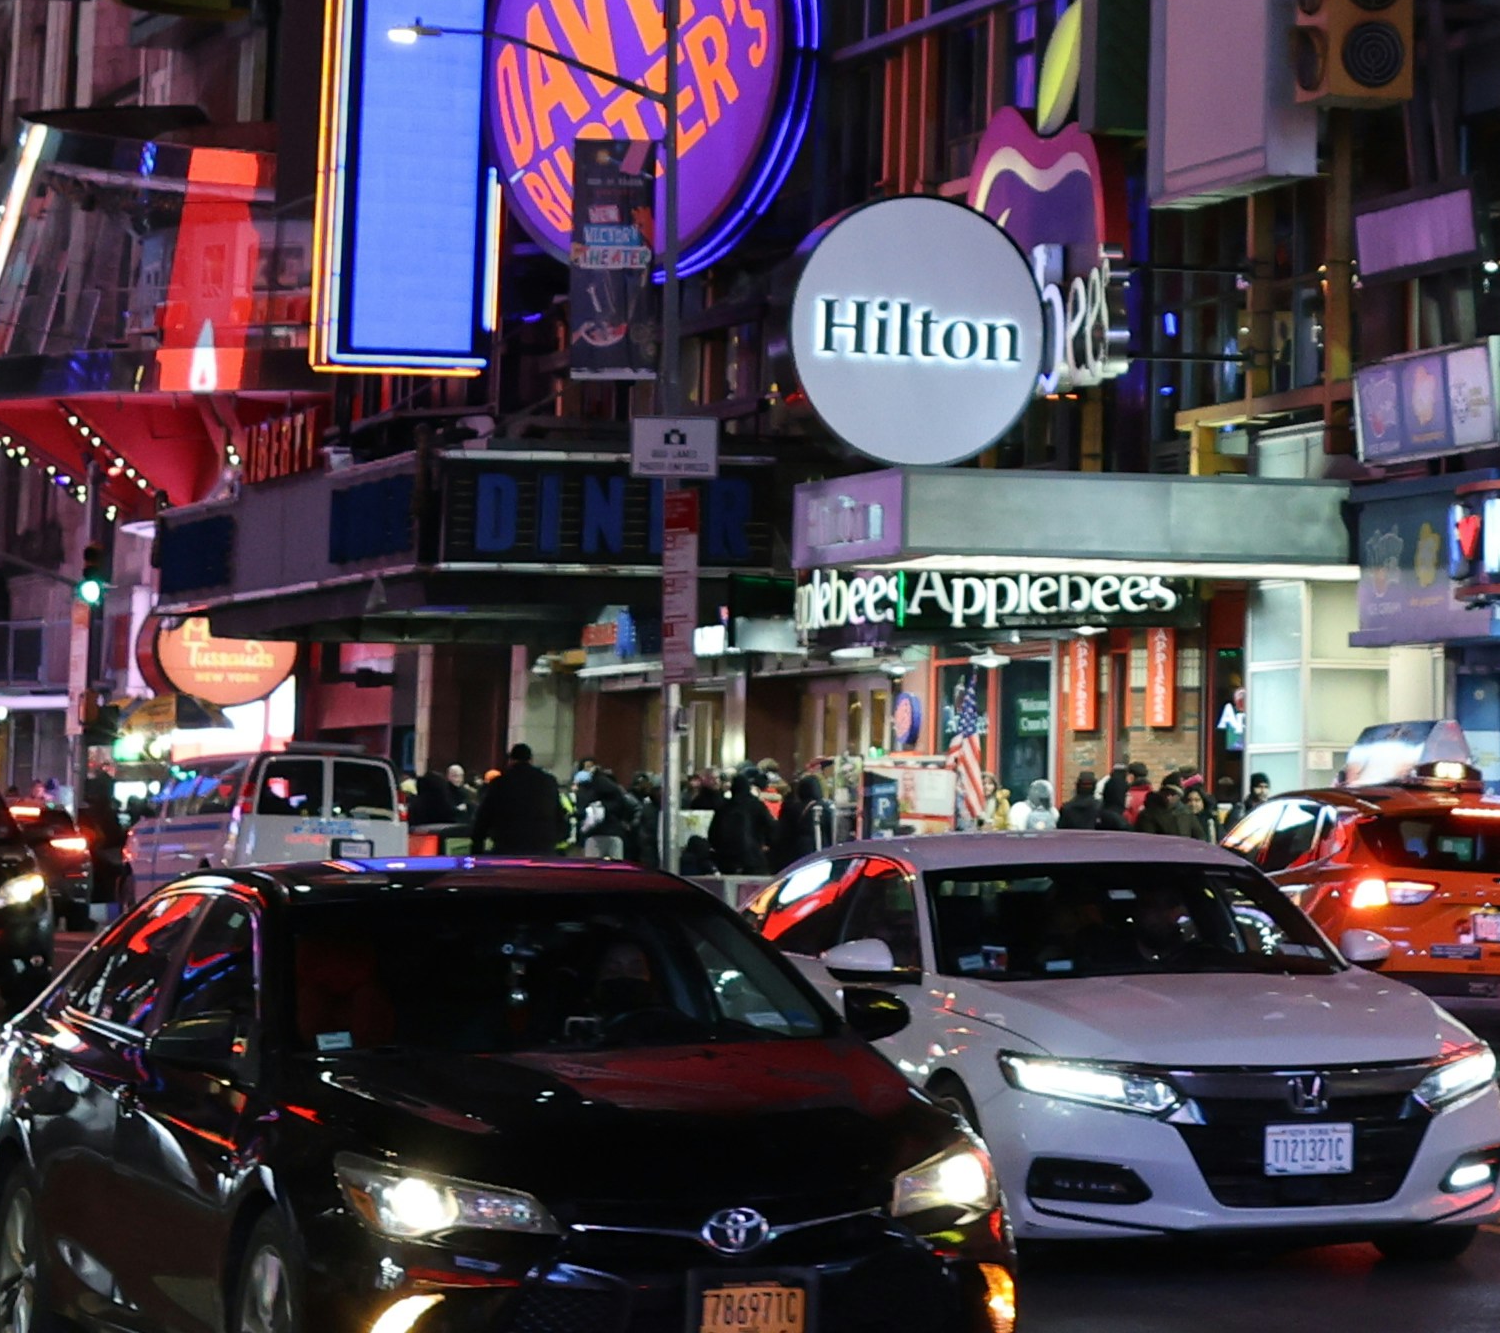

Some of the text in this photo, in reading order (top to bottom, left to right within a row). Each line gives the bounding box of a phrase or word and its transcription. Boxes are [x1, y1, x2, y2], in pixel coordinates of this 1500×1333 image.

[816, 297, 1021, 365] Hilton
[183, 640, 276, 670] Tussauds
[1272, 1136, 1344, 1162] T121321C
